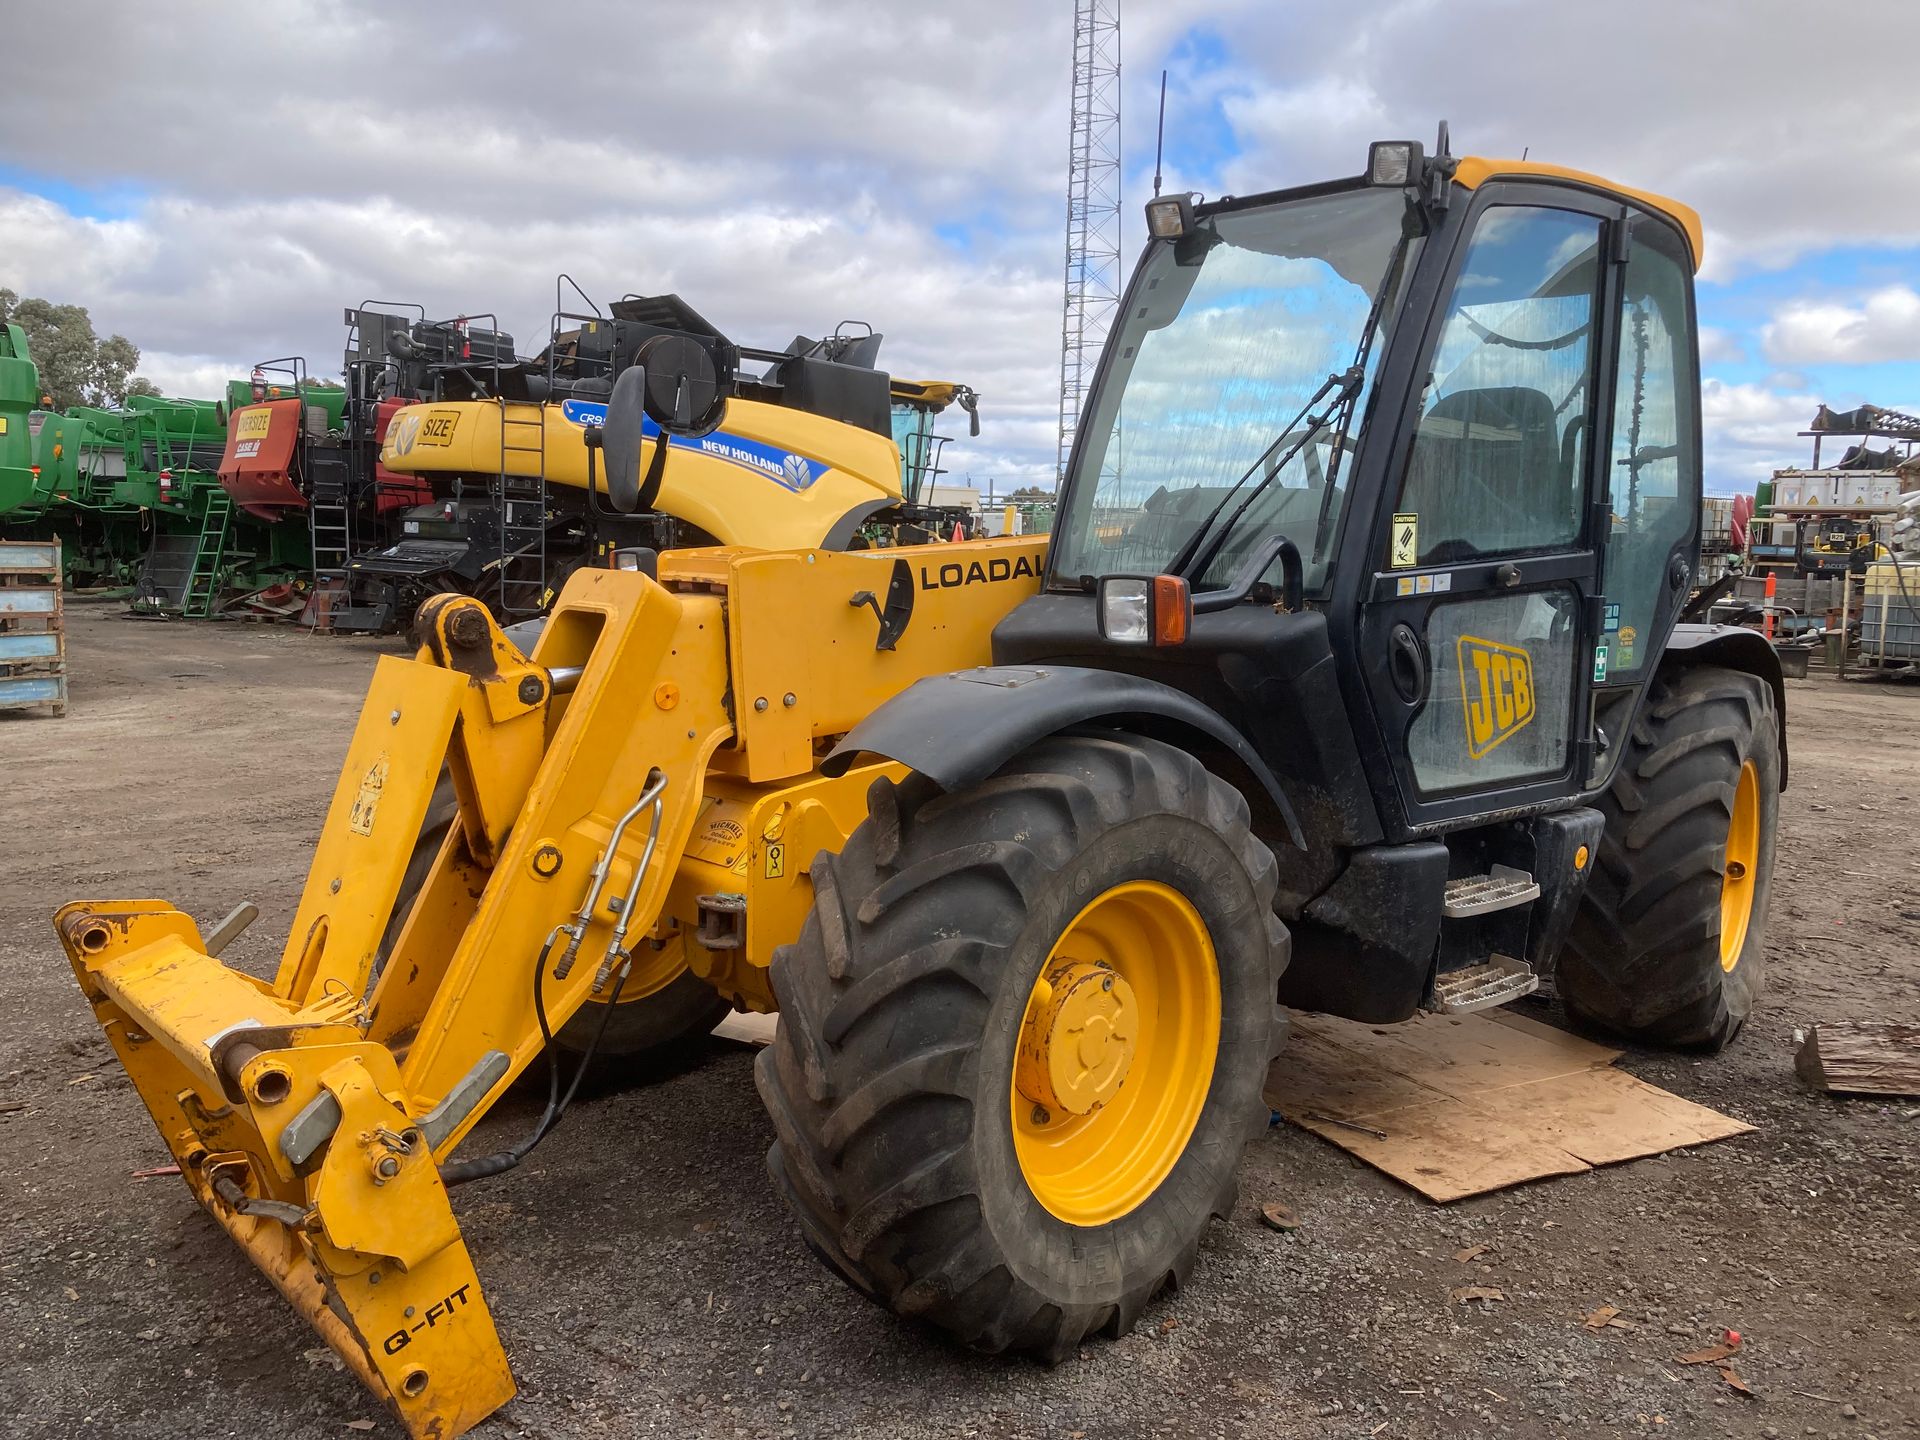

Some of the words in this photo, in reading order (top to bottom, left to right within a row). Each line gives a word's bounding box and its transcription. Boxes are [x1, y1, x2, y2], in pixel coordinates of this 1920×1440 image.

[239, 415, 268, 432] OVERSIZE
[423, 418, 452, 437] SIZE
[236, 442, 253, 452] CASE
[702, 440, 730, 456] NEW
[731, 447, 784, 476] HOLLAND
[1471, 649, 1531, 745] JCB
[710, 821, 743, 840] MICHAELS
[383, 1283, 470, 1356] Q-FIT
